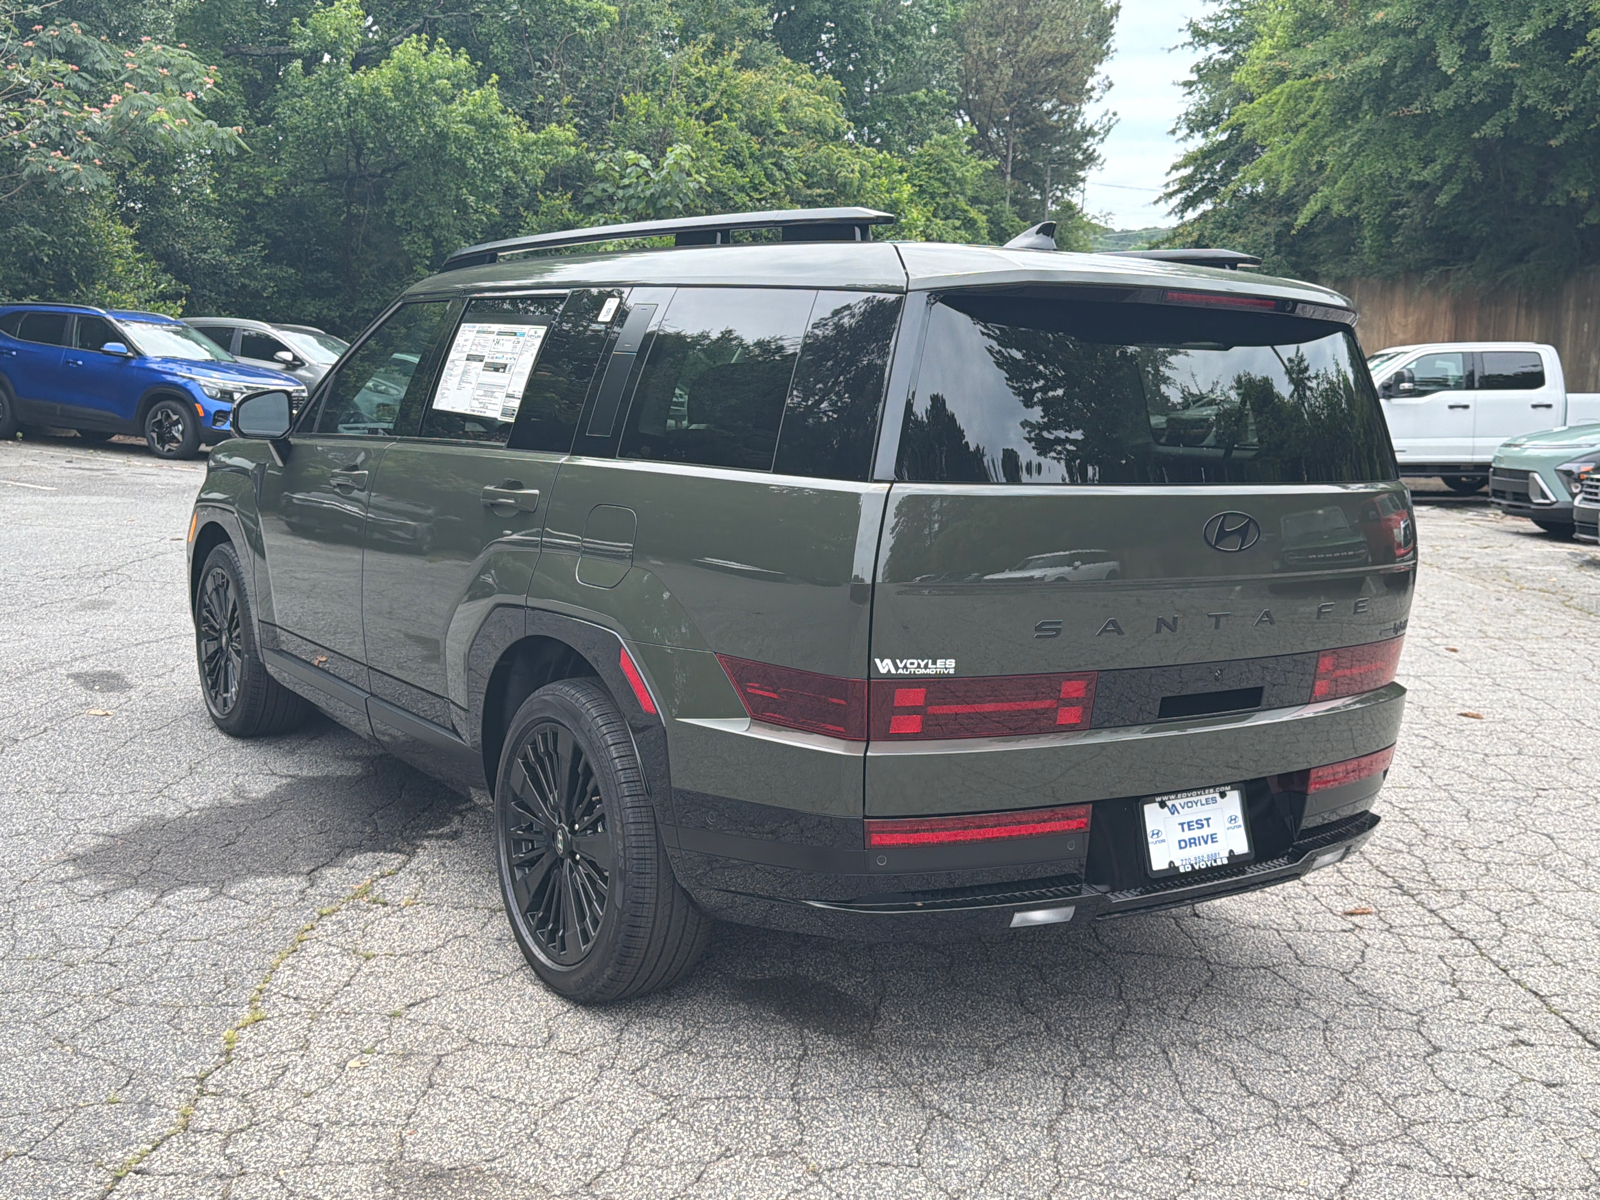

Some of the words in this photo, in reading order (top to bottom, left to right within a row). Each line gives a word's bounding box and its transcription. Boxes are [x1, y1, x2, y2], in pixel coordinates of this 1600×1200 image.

[1034, 609, 1276, 639] SANTA
[1316, 597, 1371, 620] FE
[896, 659, 956, 668] VOYLES
[1155, 786, 1231, 802] WWW.EDVOYLES.COM
[1179, 796, 1217, 809] VOYLES
[1178, 817, 1211, 832] TEST
[1178, 833, 1218, 850] DRIVE
[1194, 857, 1228, 869] VOYLES
